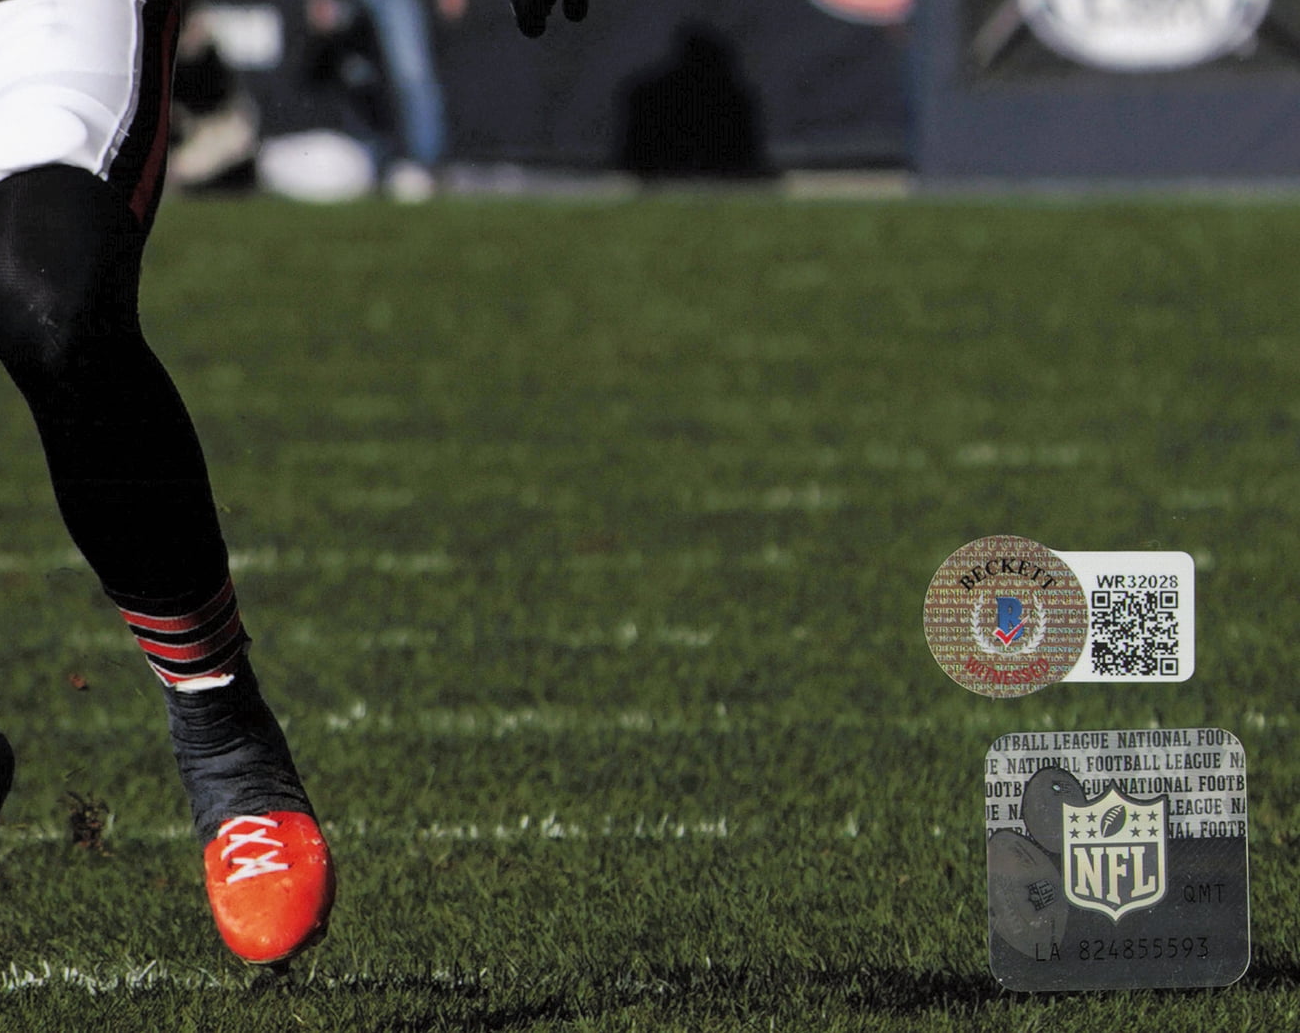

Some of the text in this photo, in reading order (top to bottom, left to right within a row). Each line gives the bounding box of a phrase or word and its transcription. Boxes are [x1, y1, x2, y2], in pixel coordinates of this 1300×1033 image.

[959, 558, 1057, 591] BECKETT
[1096, 574, 1179, 588] WR32028
[964, 656, 1051, 685] WITNESSED
[1053, 732, 1109, 750] LEAGUE
[1117, 730, 1191, 748] NATIONAL
[1086, 753, 1160, 772] FOOTBALL
[1165, 752, 1221, 770] LEAGUE
[1120, 776, 1193, 794] NATIONAL
[1168, 798, 1222, 815] LEAGUE
[1073, 846, 1156, 905] NFL
[1183, 883, 1226, 904] QMT
[1035, 936, 1209, 962] LA 824855593
